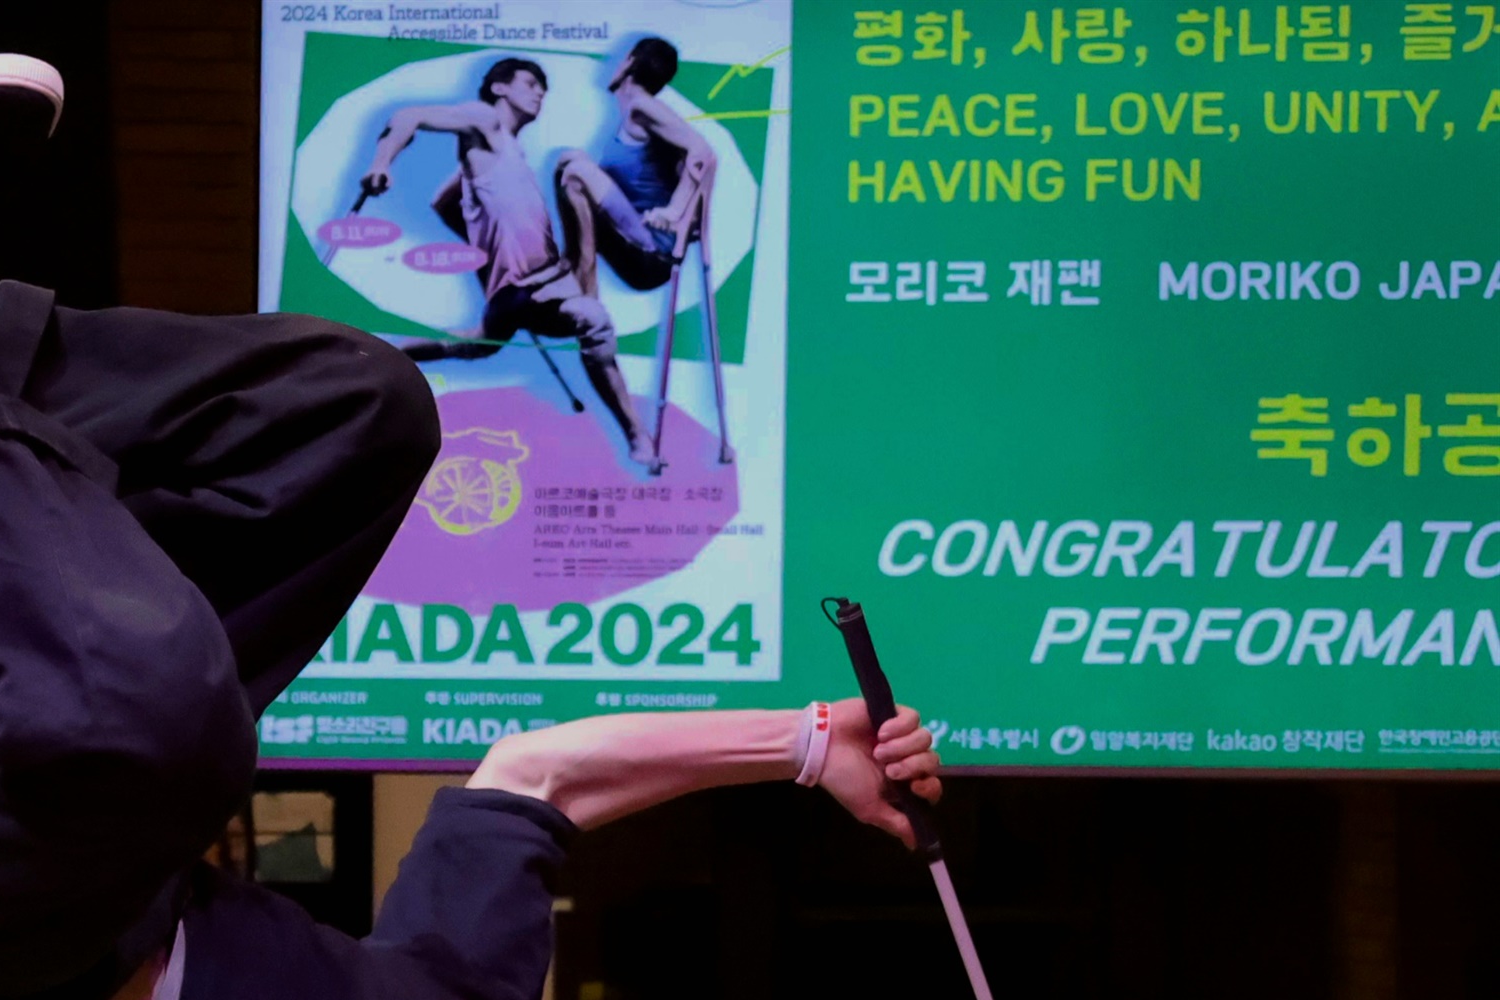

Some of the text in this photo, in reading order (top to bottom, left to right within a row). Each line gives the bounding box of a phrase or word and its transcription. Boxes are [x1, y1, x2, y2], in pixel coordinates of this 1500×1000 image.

[281, 3, 500, 22] 2024 Korea International
[387, 23, 608, 42] Accessible Dance Festival
[853, 9, 987, 69] 평화,
[1012, 6, 1149, 66] 사랑,
[1174, 5, 1373, 65] 하나됨,
[849, 93, 1054, 144] PEACE,
[1074, 92, 1241, 143] LOVE,
[1263, 89, 1455, 141] UNITY,
[847, 158, 1202, 203] HAVING FUN
[845, 260, 1101, 305] 모리코 재팬
[1158, 260, 1360, 301] MORIKO
[311, 603, 535, 665] IADA
[1207, 729, 1277, 751] kakao
